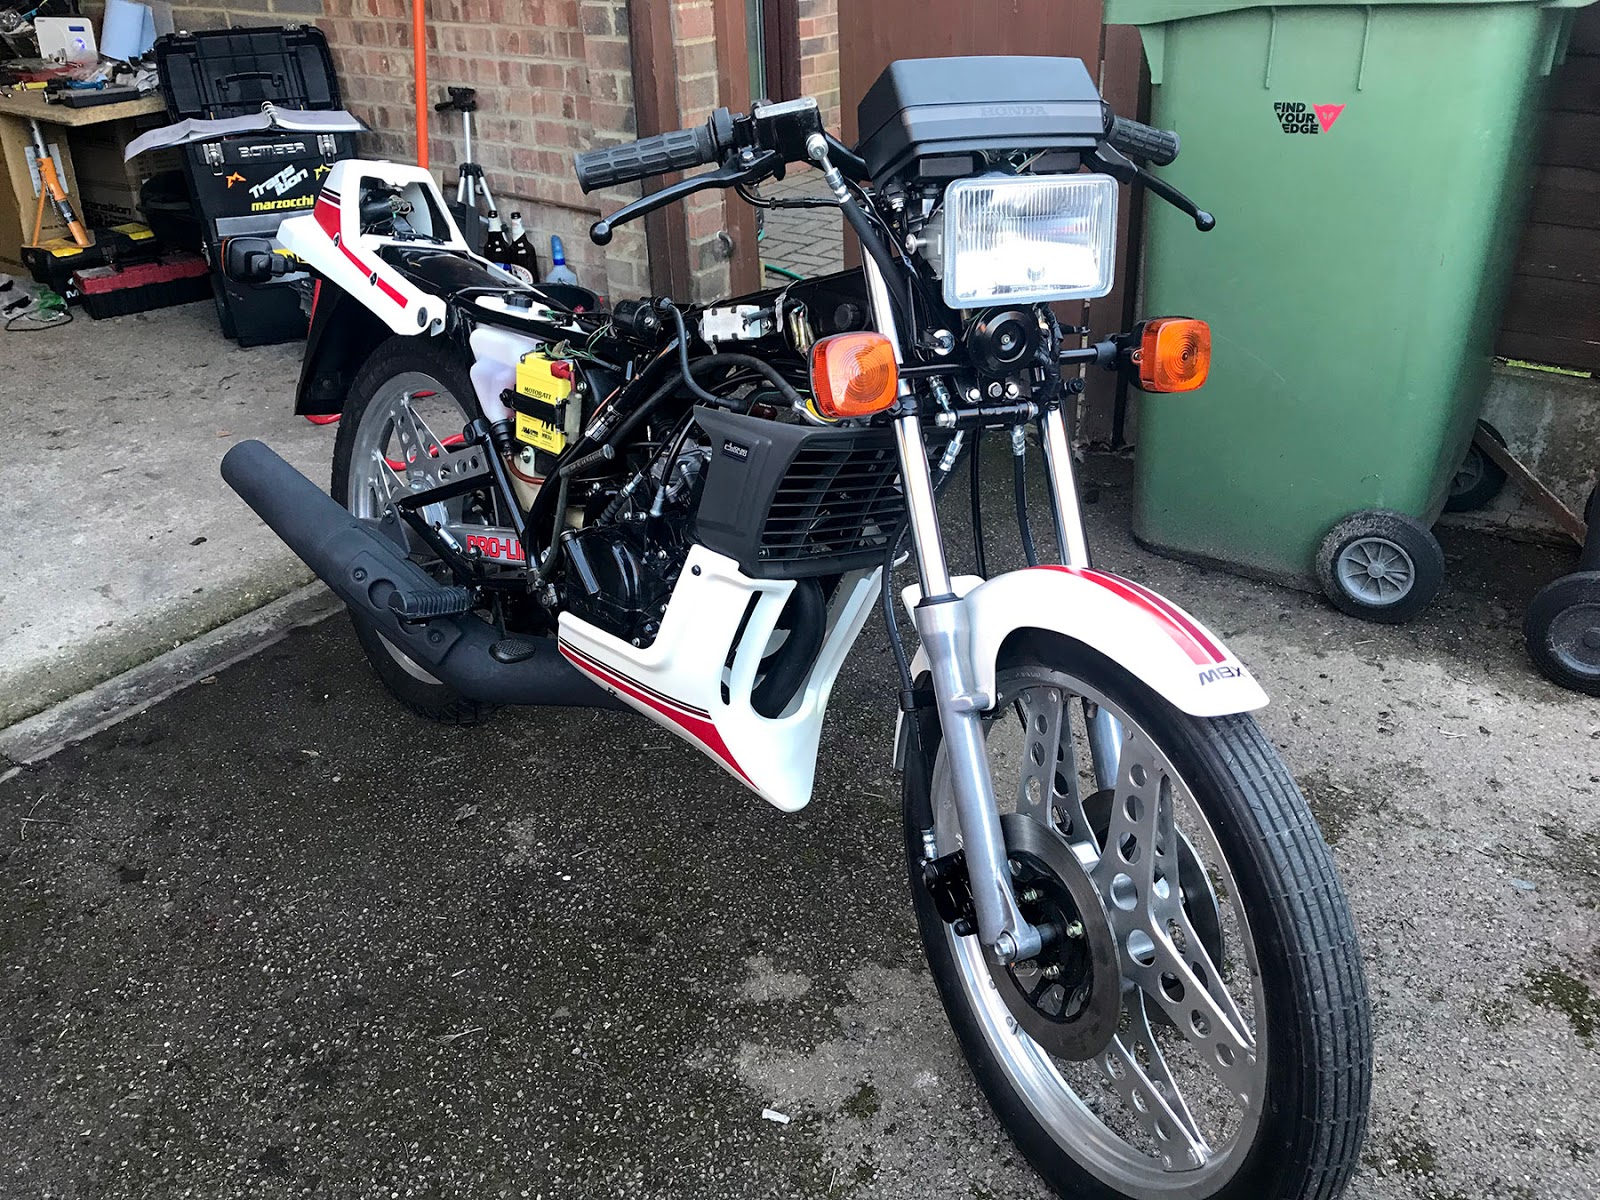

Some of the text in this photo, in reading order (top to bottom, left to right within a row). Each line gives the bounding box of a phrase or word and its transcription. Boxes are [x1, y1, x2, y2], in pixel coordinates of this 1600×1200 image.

[980, 105, 1048, 117] HONDA
[1273, 102, 1306, 112] FIND
[1276, 112, 1316, 123] YOUR
[1281, 123, 1319, 134] EDGE
[251, 194, 314, 212] marzocchi
[523, 386, 552, 400] MOTOBATT
[1198, 666, 1247, 686] MBX
